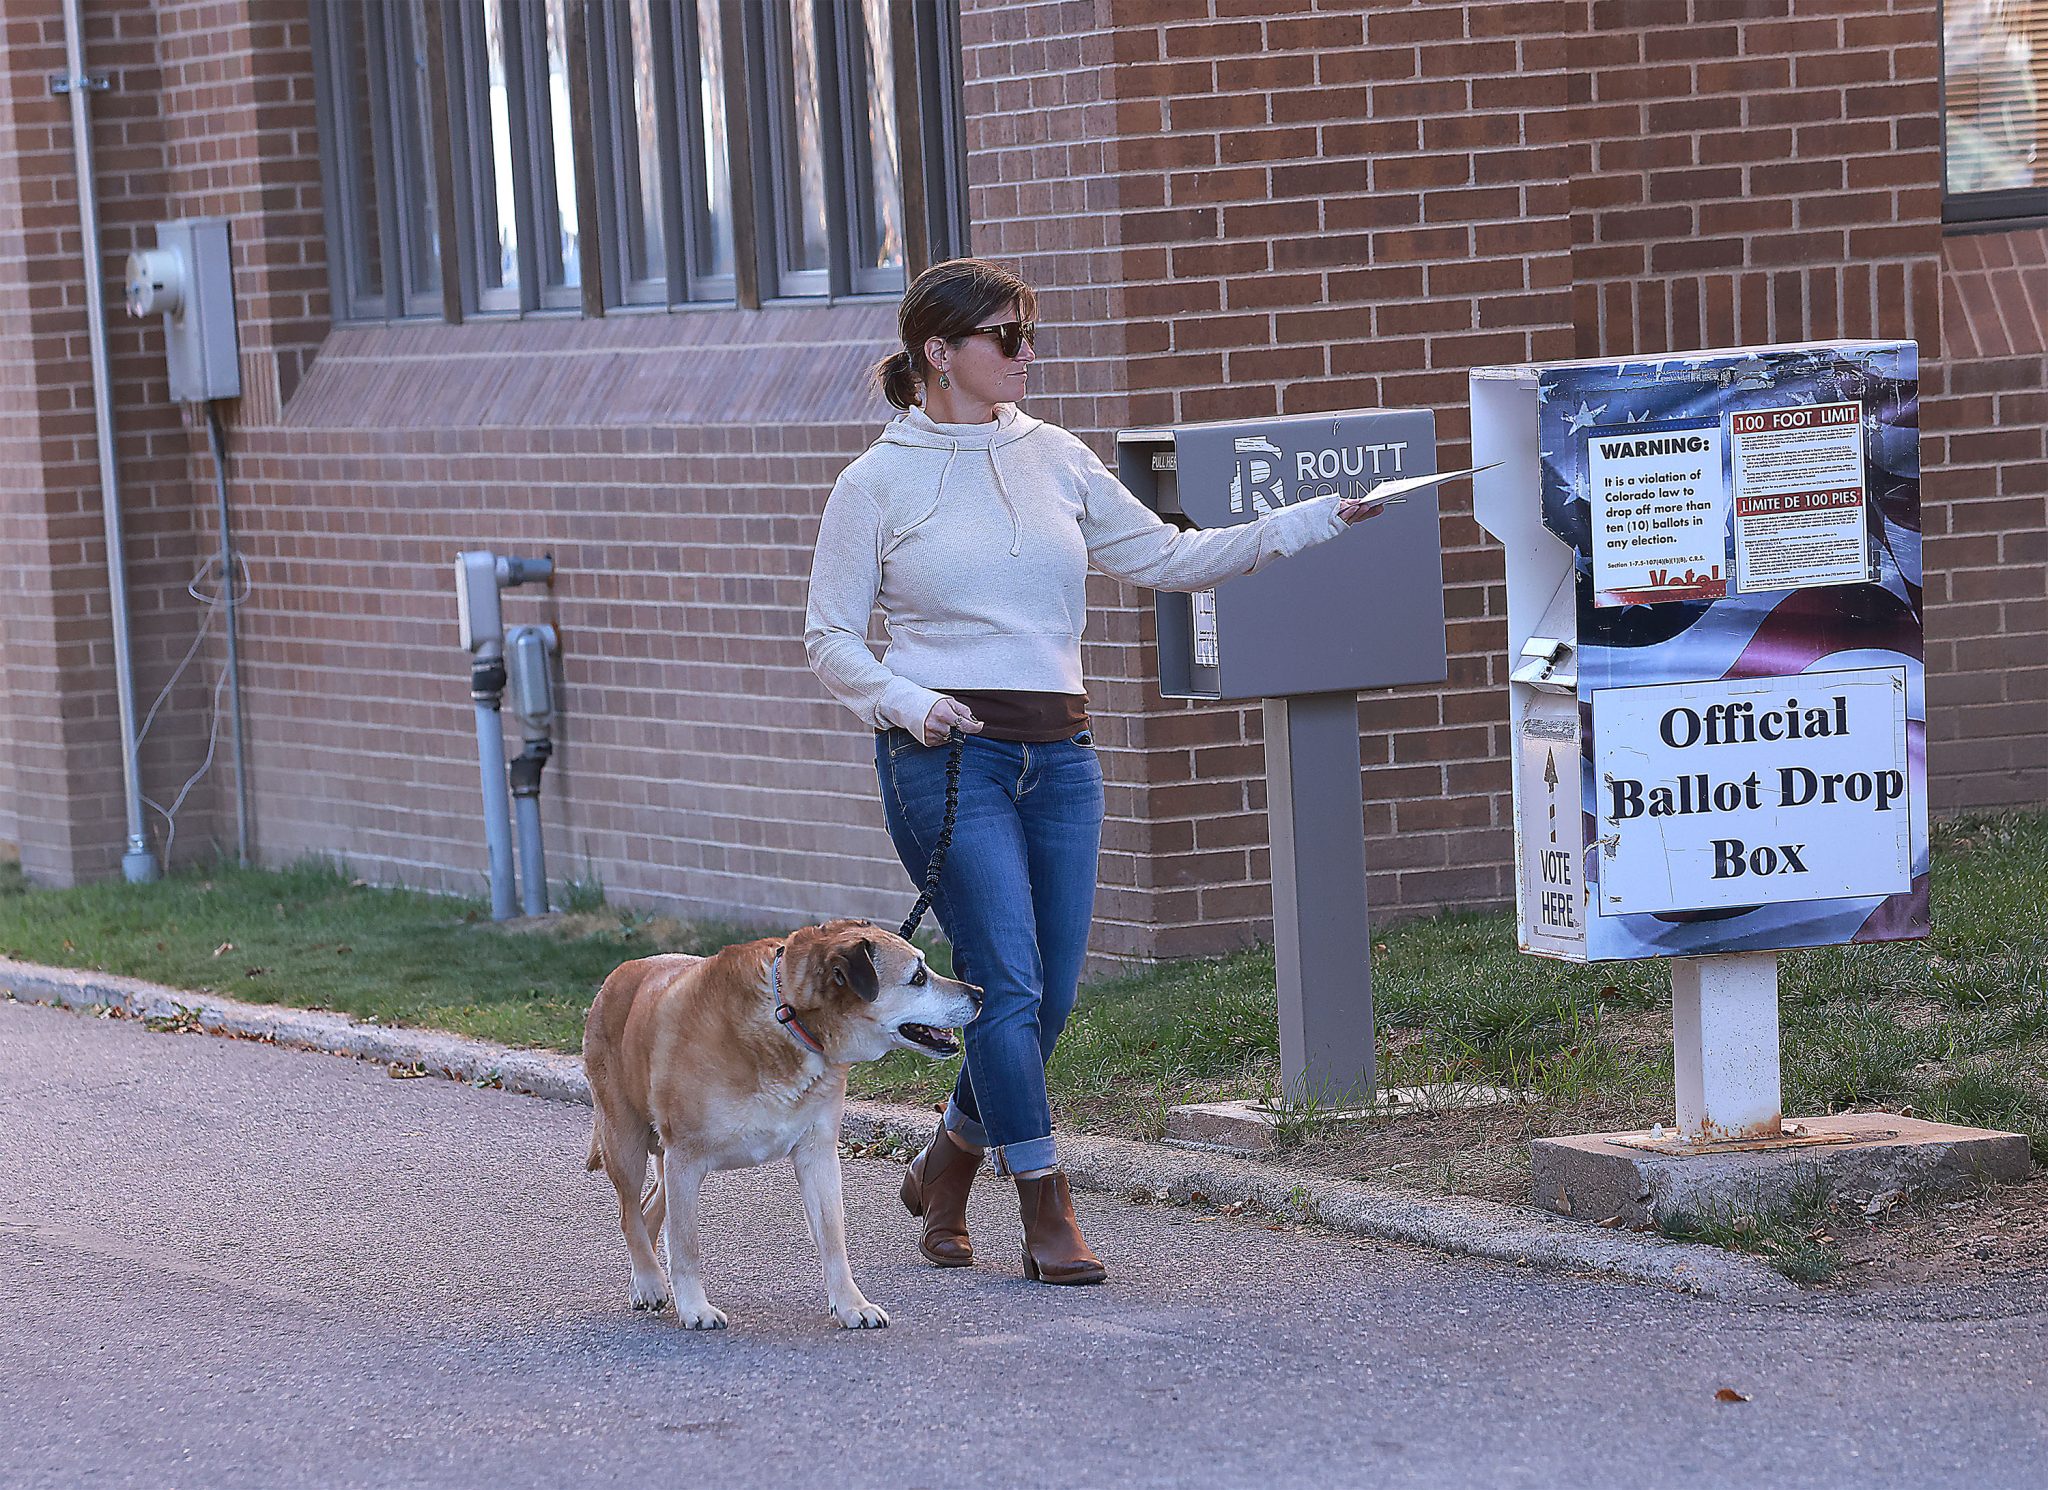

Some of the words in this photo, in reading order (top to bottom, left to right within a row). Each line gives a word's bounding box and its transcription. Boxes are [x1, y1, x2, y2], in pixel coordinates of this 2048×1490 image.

[1738, 415, 1764, 431] 100
[1773, 411, 1813, 428] FOOT
[1821, 407, 1857, 424] LIMIT
[1600, 436, 1710, 460] WARNING:
[1152, 455, 1166, 468] PULL
[1296, 441, 1408, 481] ROUTT
[1605, 477, 1612, 487] It
[1615, 476, 1624, 486] is
[1627, 477, 1635, 485] a
[1638, 471, 1686, 484] violation
[1689, 469, 1701, 480] of
[1605, 489, 1655, 503] Colorado
[1659, 487, 1680, 499] law
[1683, 487, 1694, 497] to
[1742, 497, 1780, 513] LÍMITE
[1784, 496, 1800, 508] DE
[1805, 493, 1828, 507] 100
[1832, 490, 1857, 504] PIES
[1606, 506, 1632, 519] drop
[1635, 503, 1651, 514] off
[1654, 504, 1683, 514] more
[1686, 500, 1711, 510] than
[1606, 523, 1623, 533] ten
[1627, 520, 1649, 533] (10)
[1652, 517, 1689, 529] ballots
[1692, 515, 1703, 526] in
[1607, 539, 1628, 549] any
[1631, 534, 1677, 546] election.
[1607, 561, 1628, 569] Section
[1649, 565, 1719, 586] Vote!
[1659, 696, 1850, 748] Official
[1610, 771, 1762, 820] Ballot
[1776, 767, 1904, 811] Drop
[1540, 849, 1571, 885] VOTE
[1710, 838, 1808, 880] Box
[1541, 891, 1574, 928] HERE
